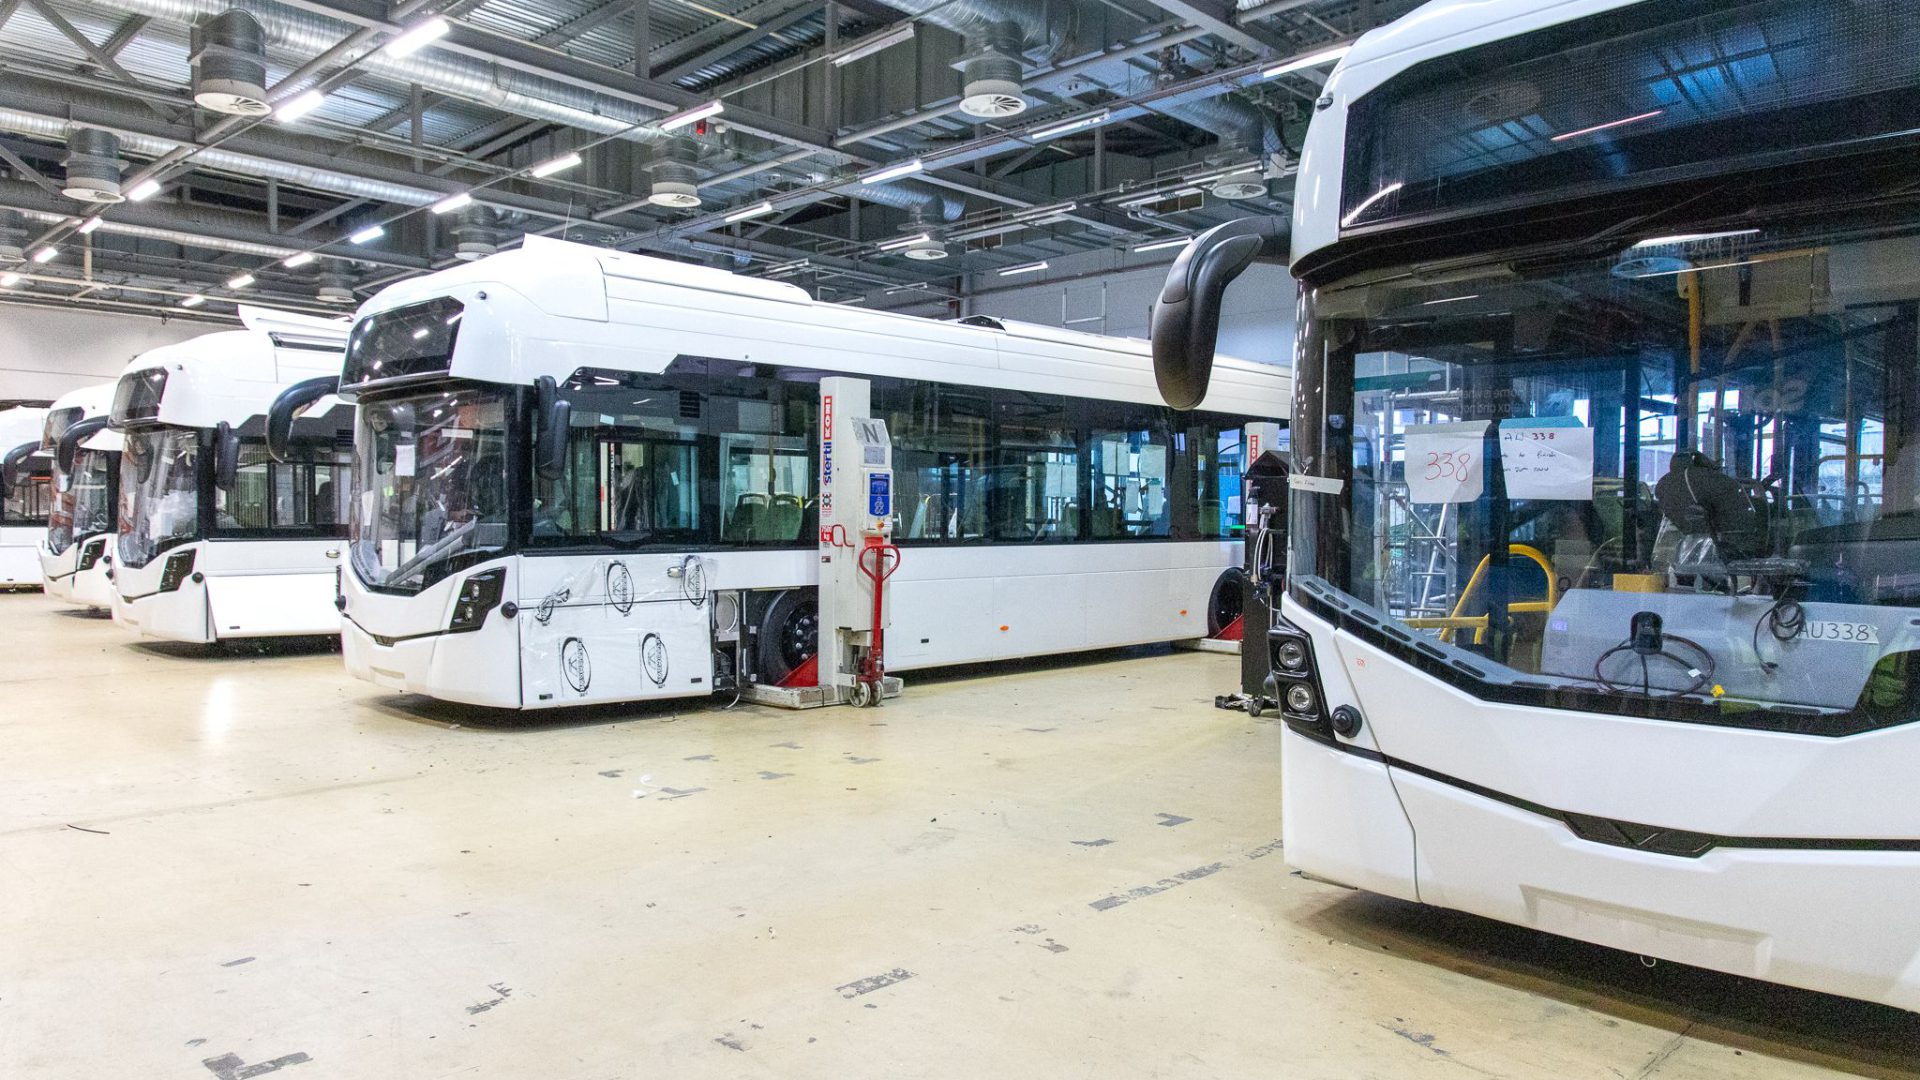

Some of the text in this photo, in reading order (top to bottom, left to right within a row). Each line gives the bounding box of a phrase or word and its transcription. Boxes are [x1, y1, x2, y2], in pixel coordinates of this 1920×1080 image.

[823, 397, 832, 485] stertil KONI
[862, 423, 880, 443] N
[1532, 432, 1555, 440] 338
[1425, 452, 1471, 482] 338
[1798, 622, 1869, 641] AU338
